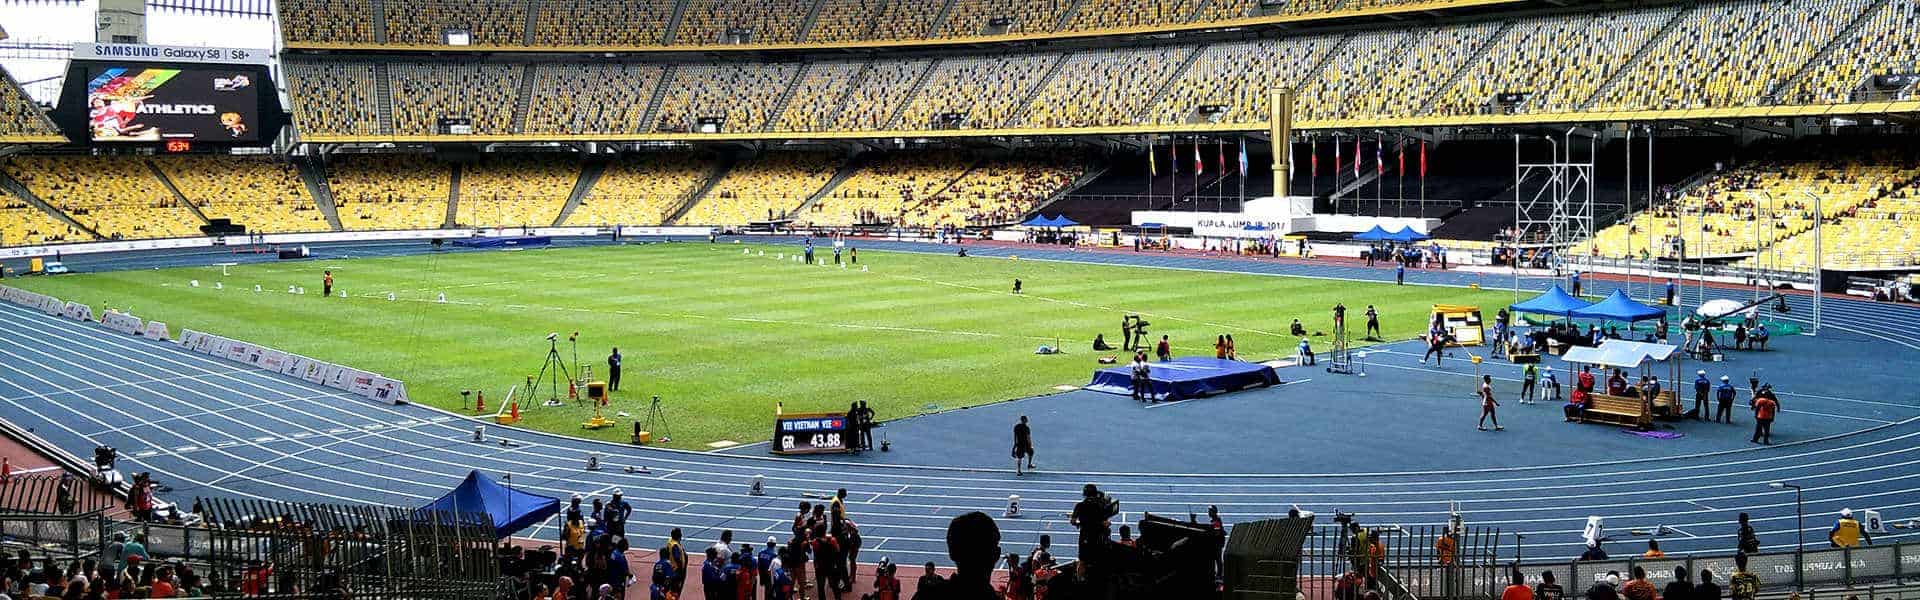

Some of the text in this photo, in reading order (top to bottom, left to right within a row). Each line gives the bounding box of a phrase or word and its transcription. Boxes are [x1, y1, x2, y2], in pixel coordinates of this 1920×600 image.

[95, 45, 250, 60] SAMSUNG Galaxy S8 S8+
[136, 103, 216, 114] ATHLETICS
[375, 387, 390, 399] TM
[794, 419, 820, 431] VIETNAM
[782, 432, 841, 449] GR 43.88
[590, 456, 597, 467] 3
[753, 480, 760, 494] 4
[1010, 501, 1018, 514] 5
[1870, 517, 1880, 530] 8
